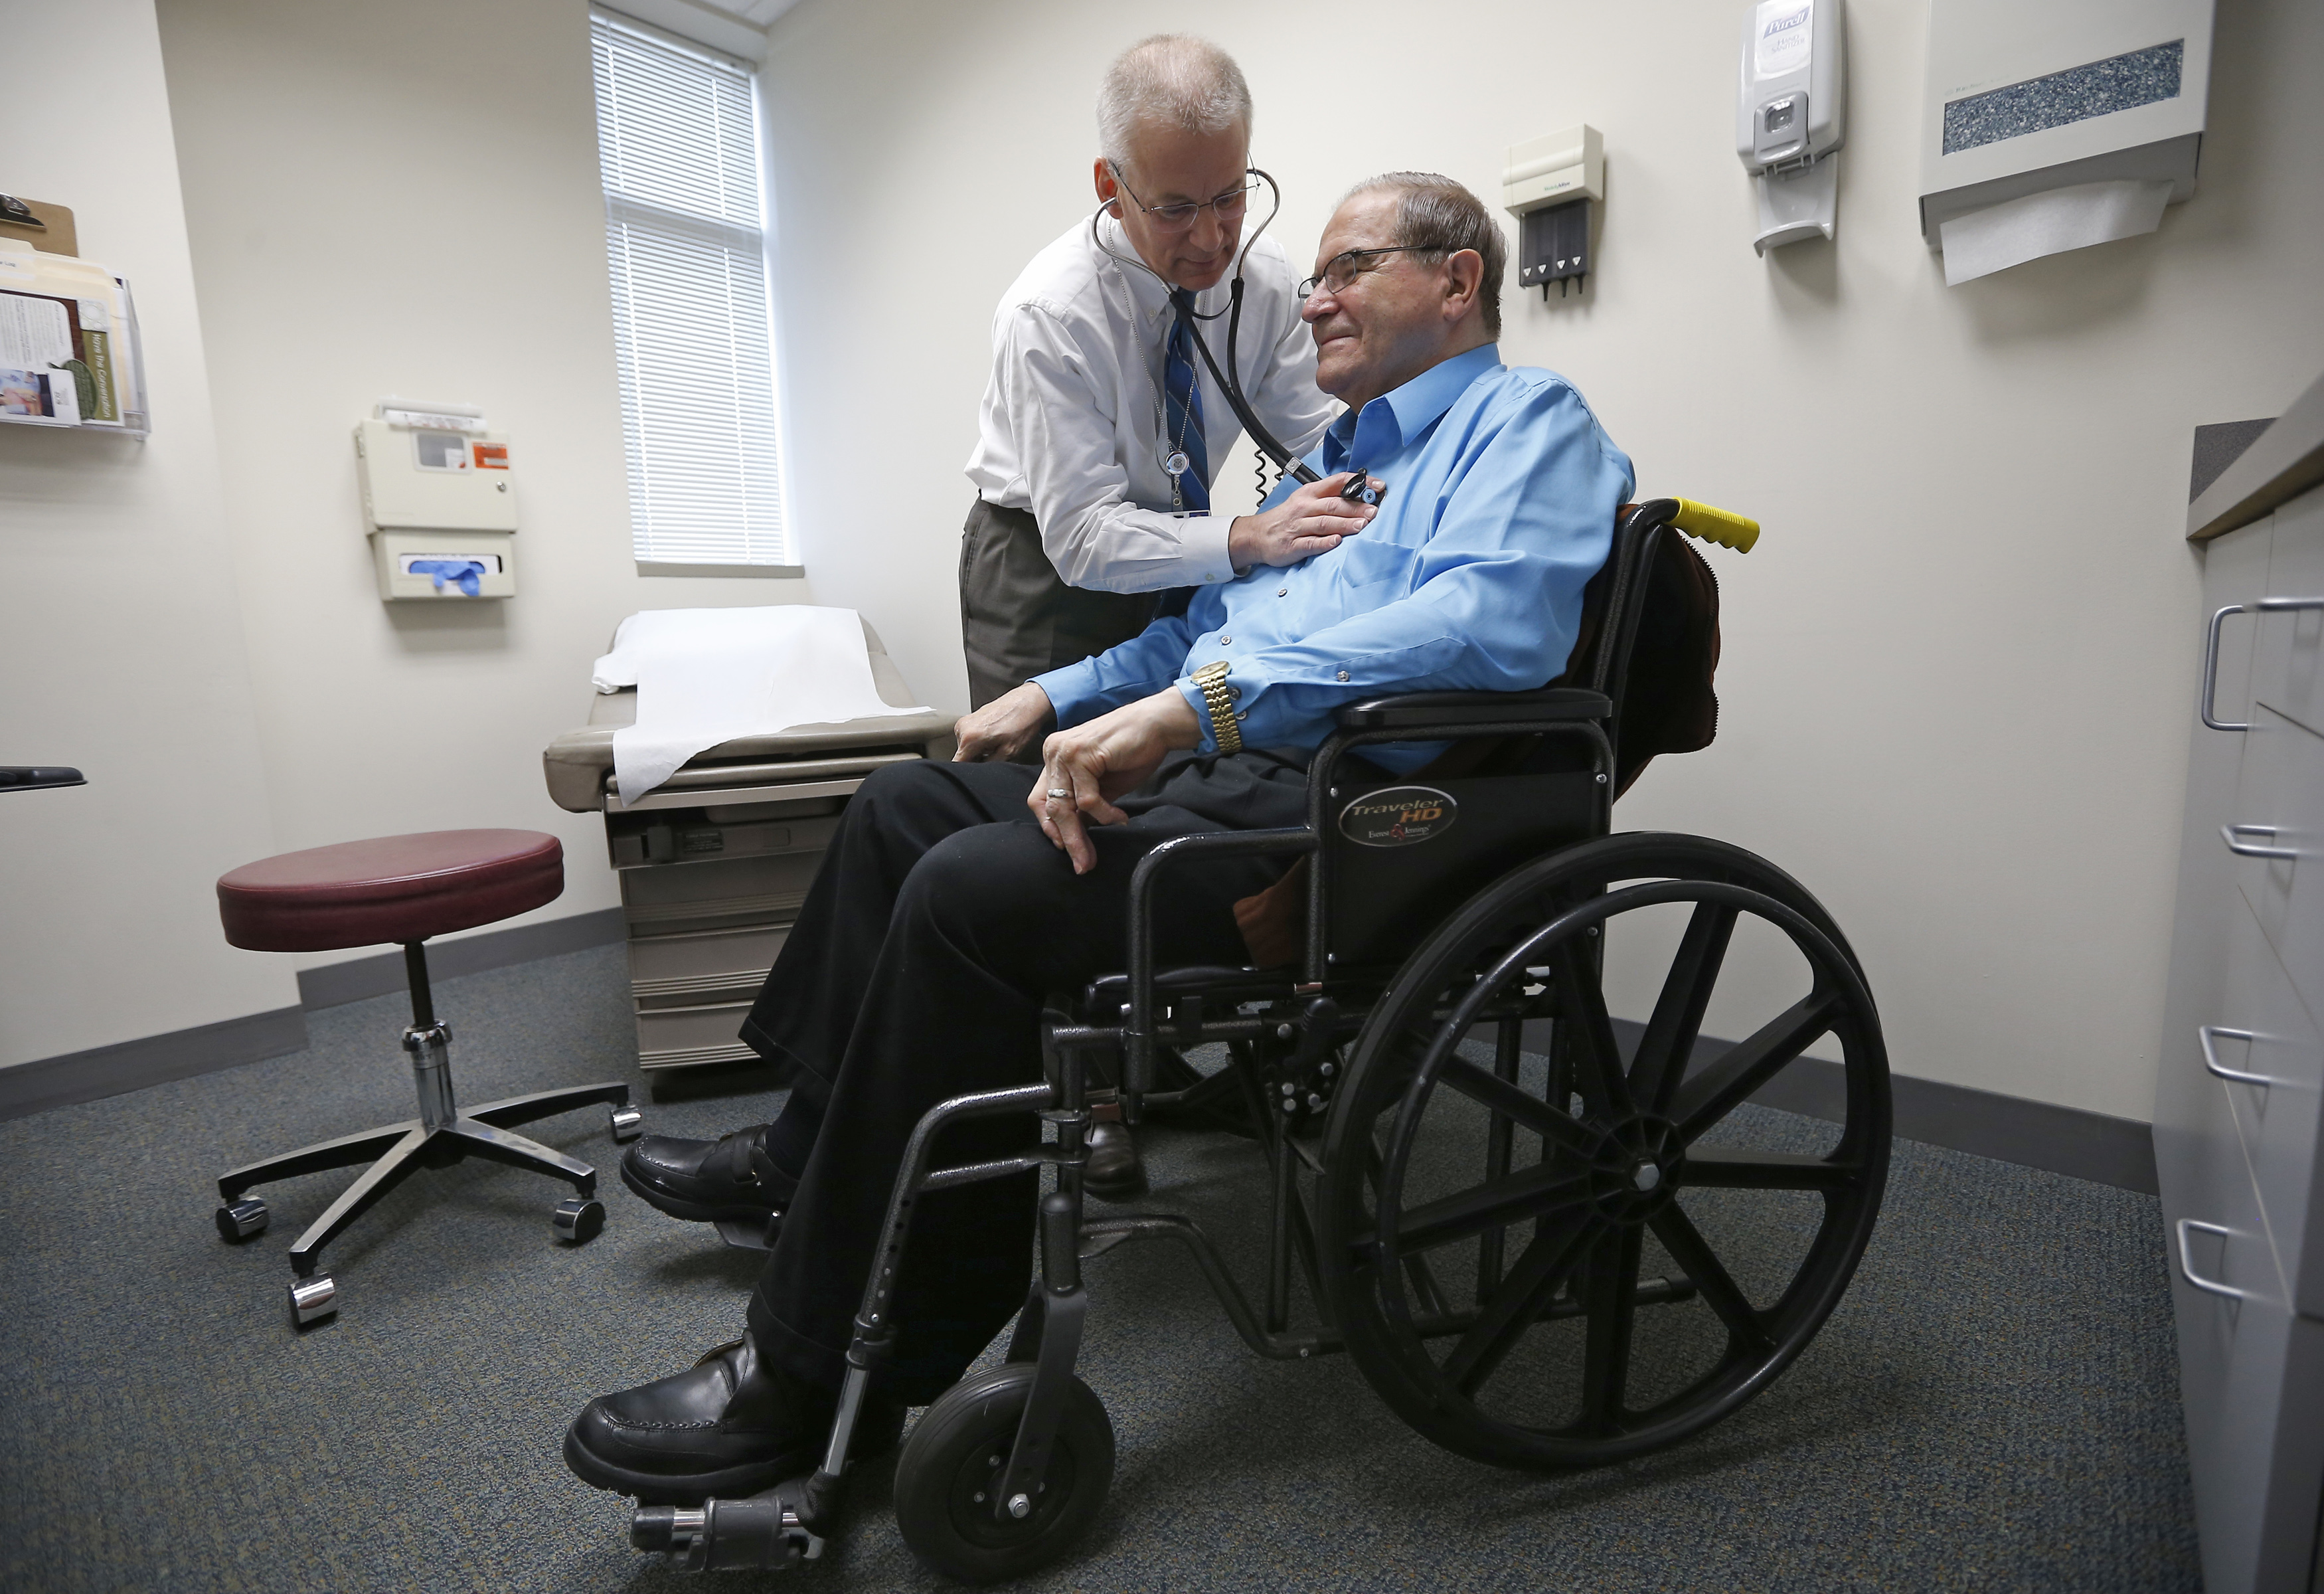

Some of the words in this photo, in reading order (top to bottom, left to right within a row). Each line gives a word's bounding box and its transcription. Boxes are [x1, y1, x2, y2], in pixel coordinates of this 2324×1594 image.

[1769, 11, 1805, 34] Purell
[1352, 800, 1444, 816] Traveler
[1399, 807, 1443, 823] HD
